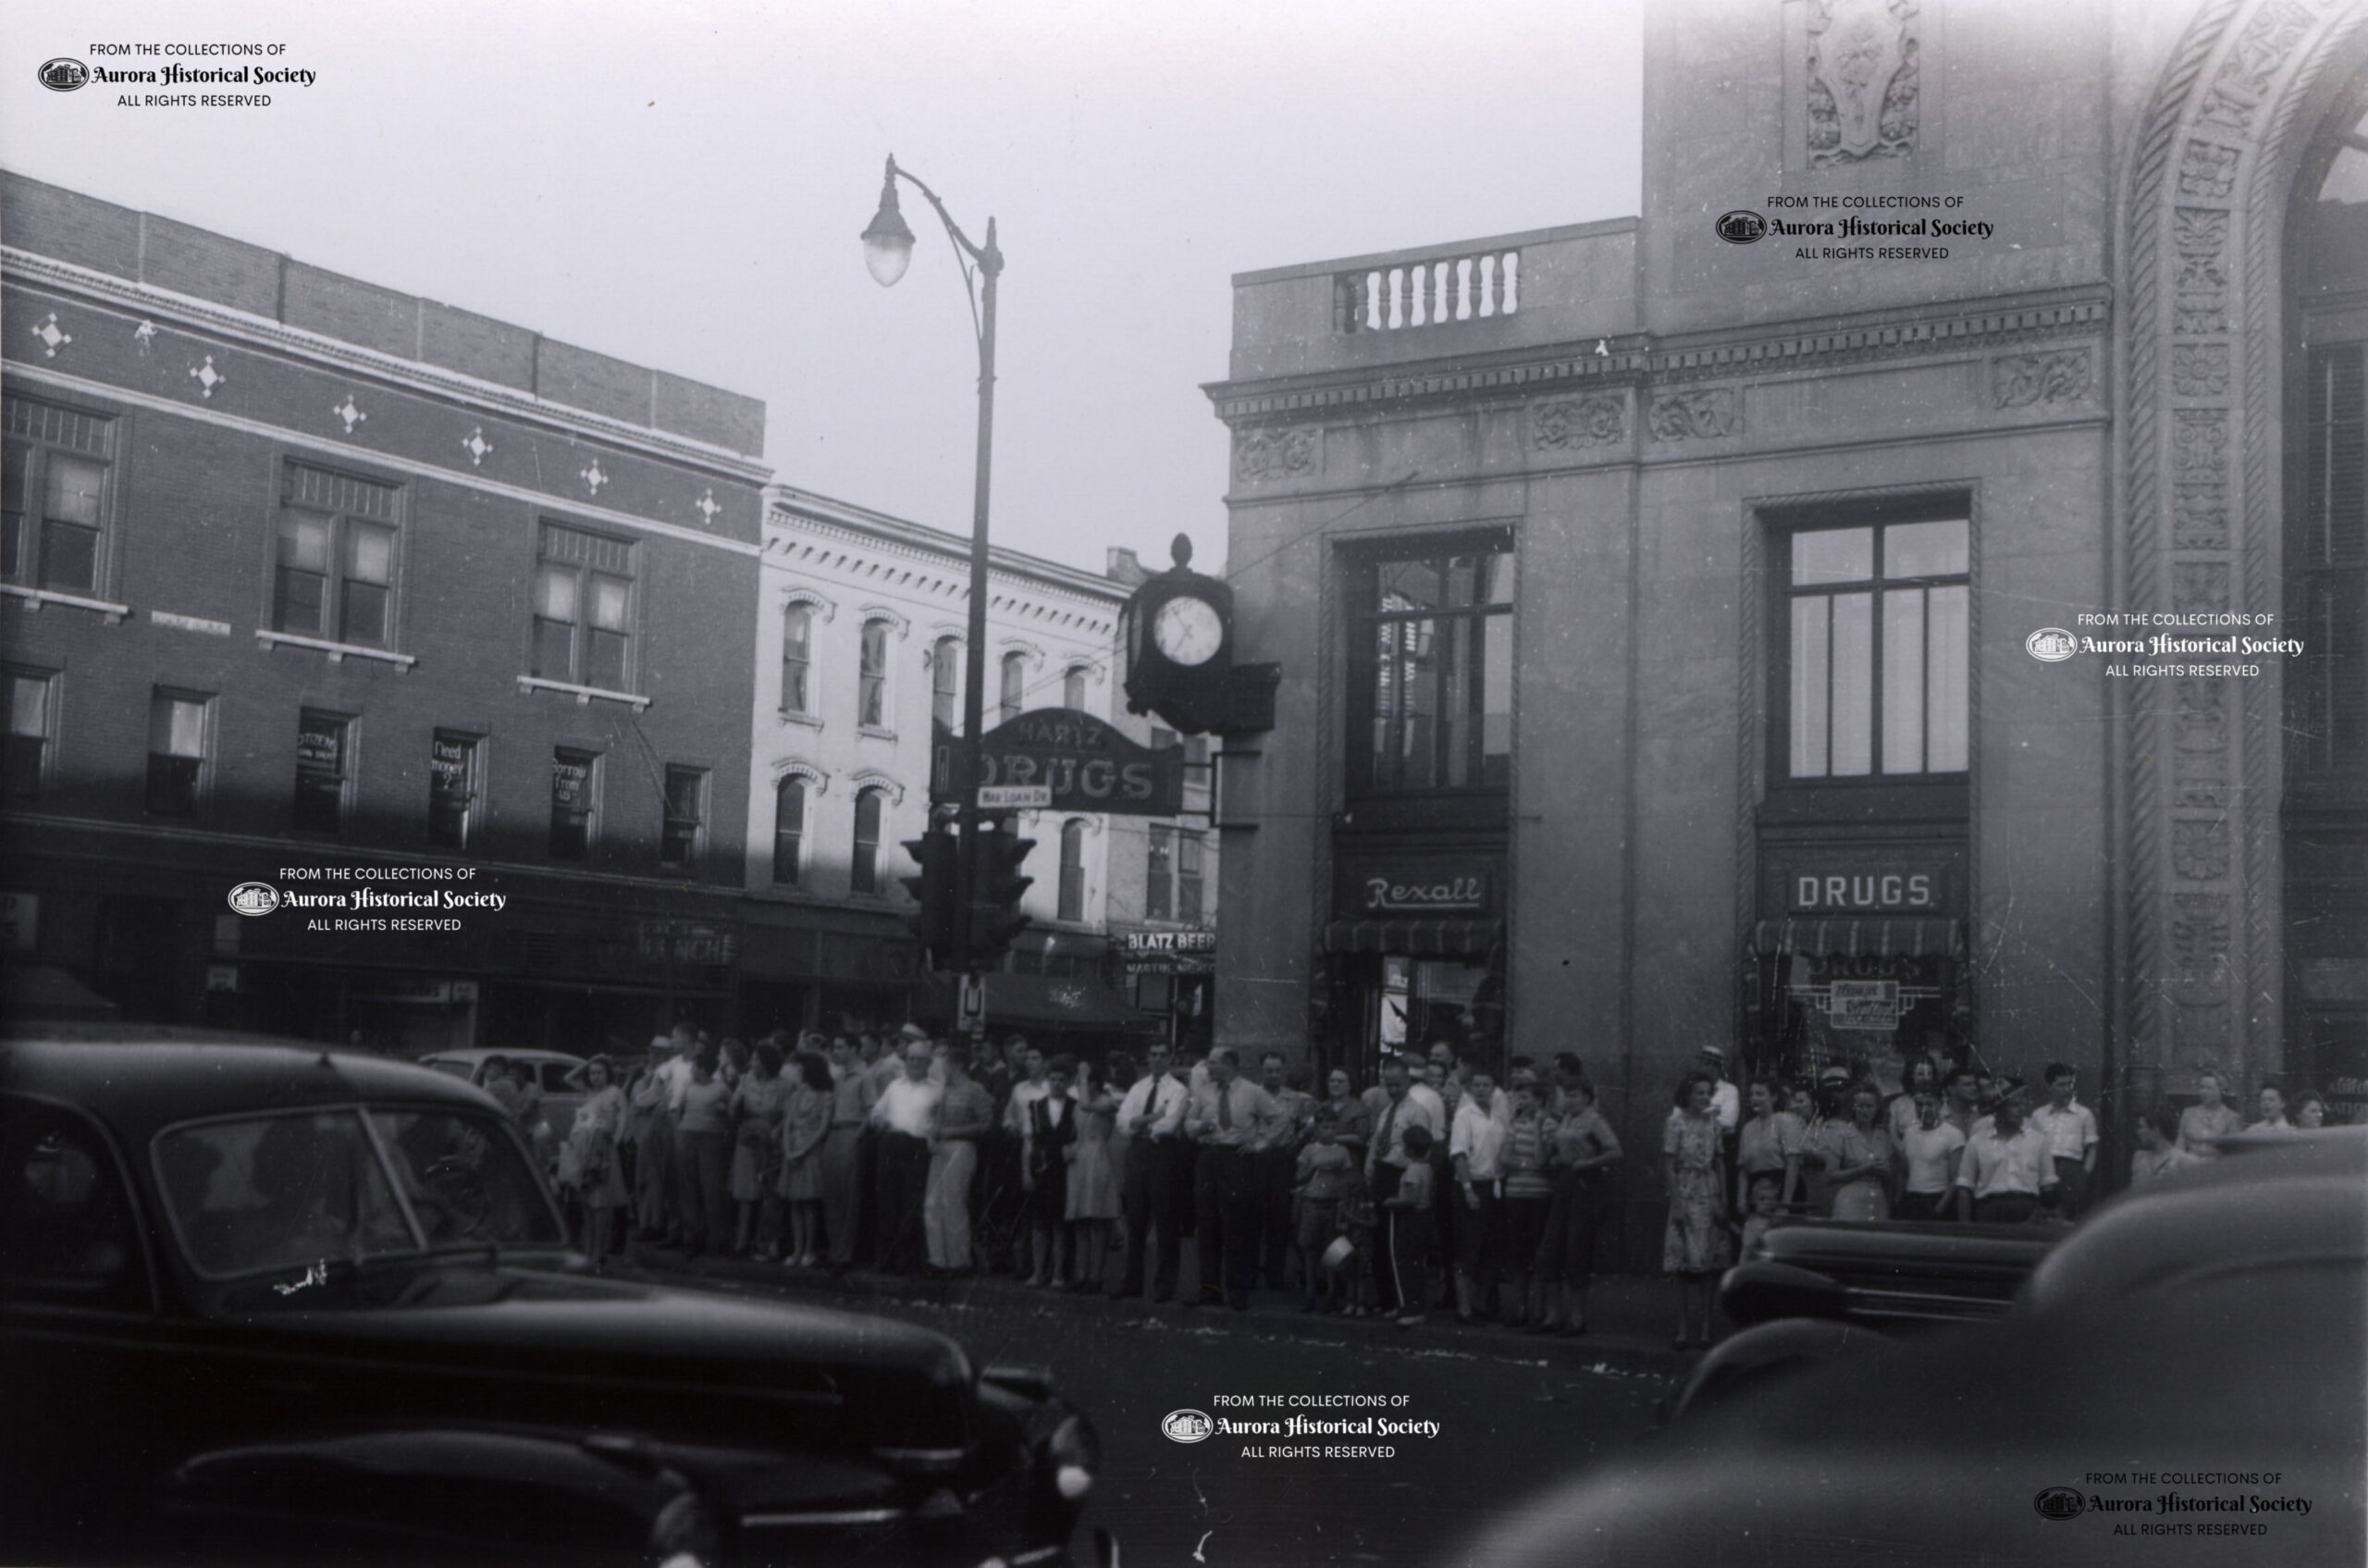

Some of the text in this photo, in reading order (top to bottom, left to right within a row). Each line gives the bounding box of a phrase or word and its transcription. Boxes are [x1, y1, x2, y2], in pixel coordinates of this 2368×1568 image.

[435, 740, 462, 759] Need
[1366, 878, 1481, 908] Rexall
[1798, 874, 1930, 907] DRUGS
[1128, 932, 1174, 950] BLATZ
